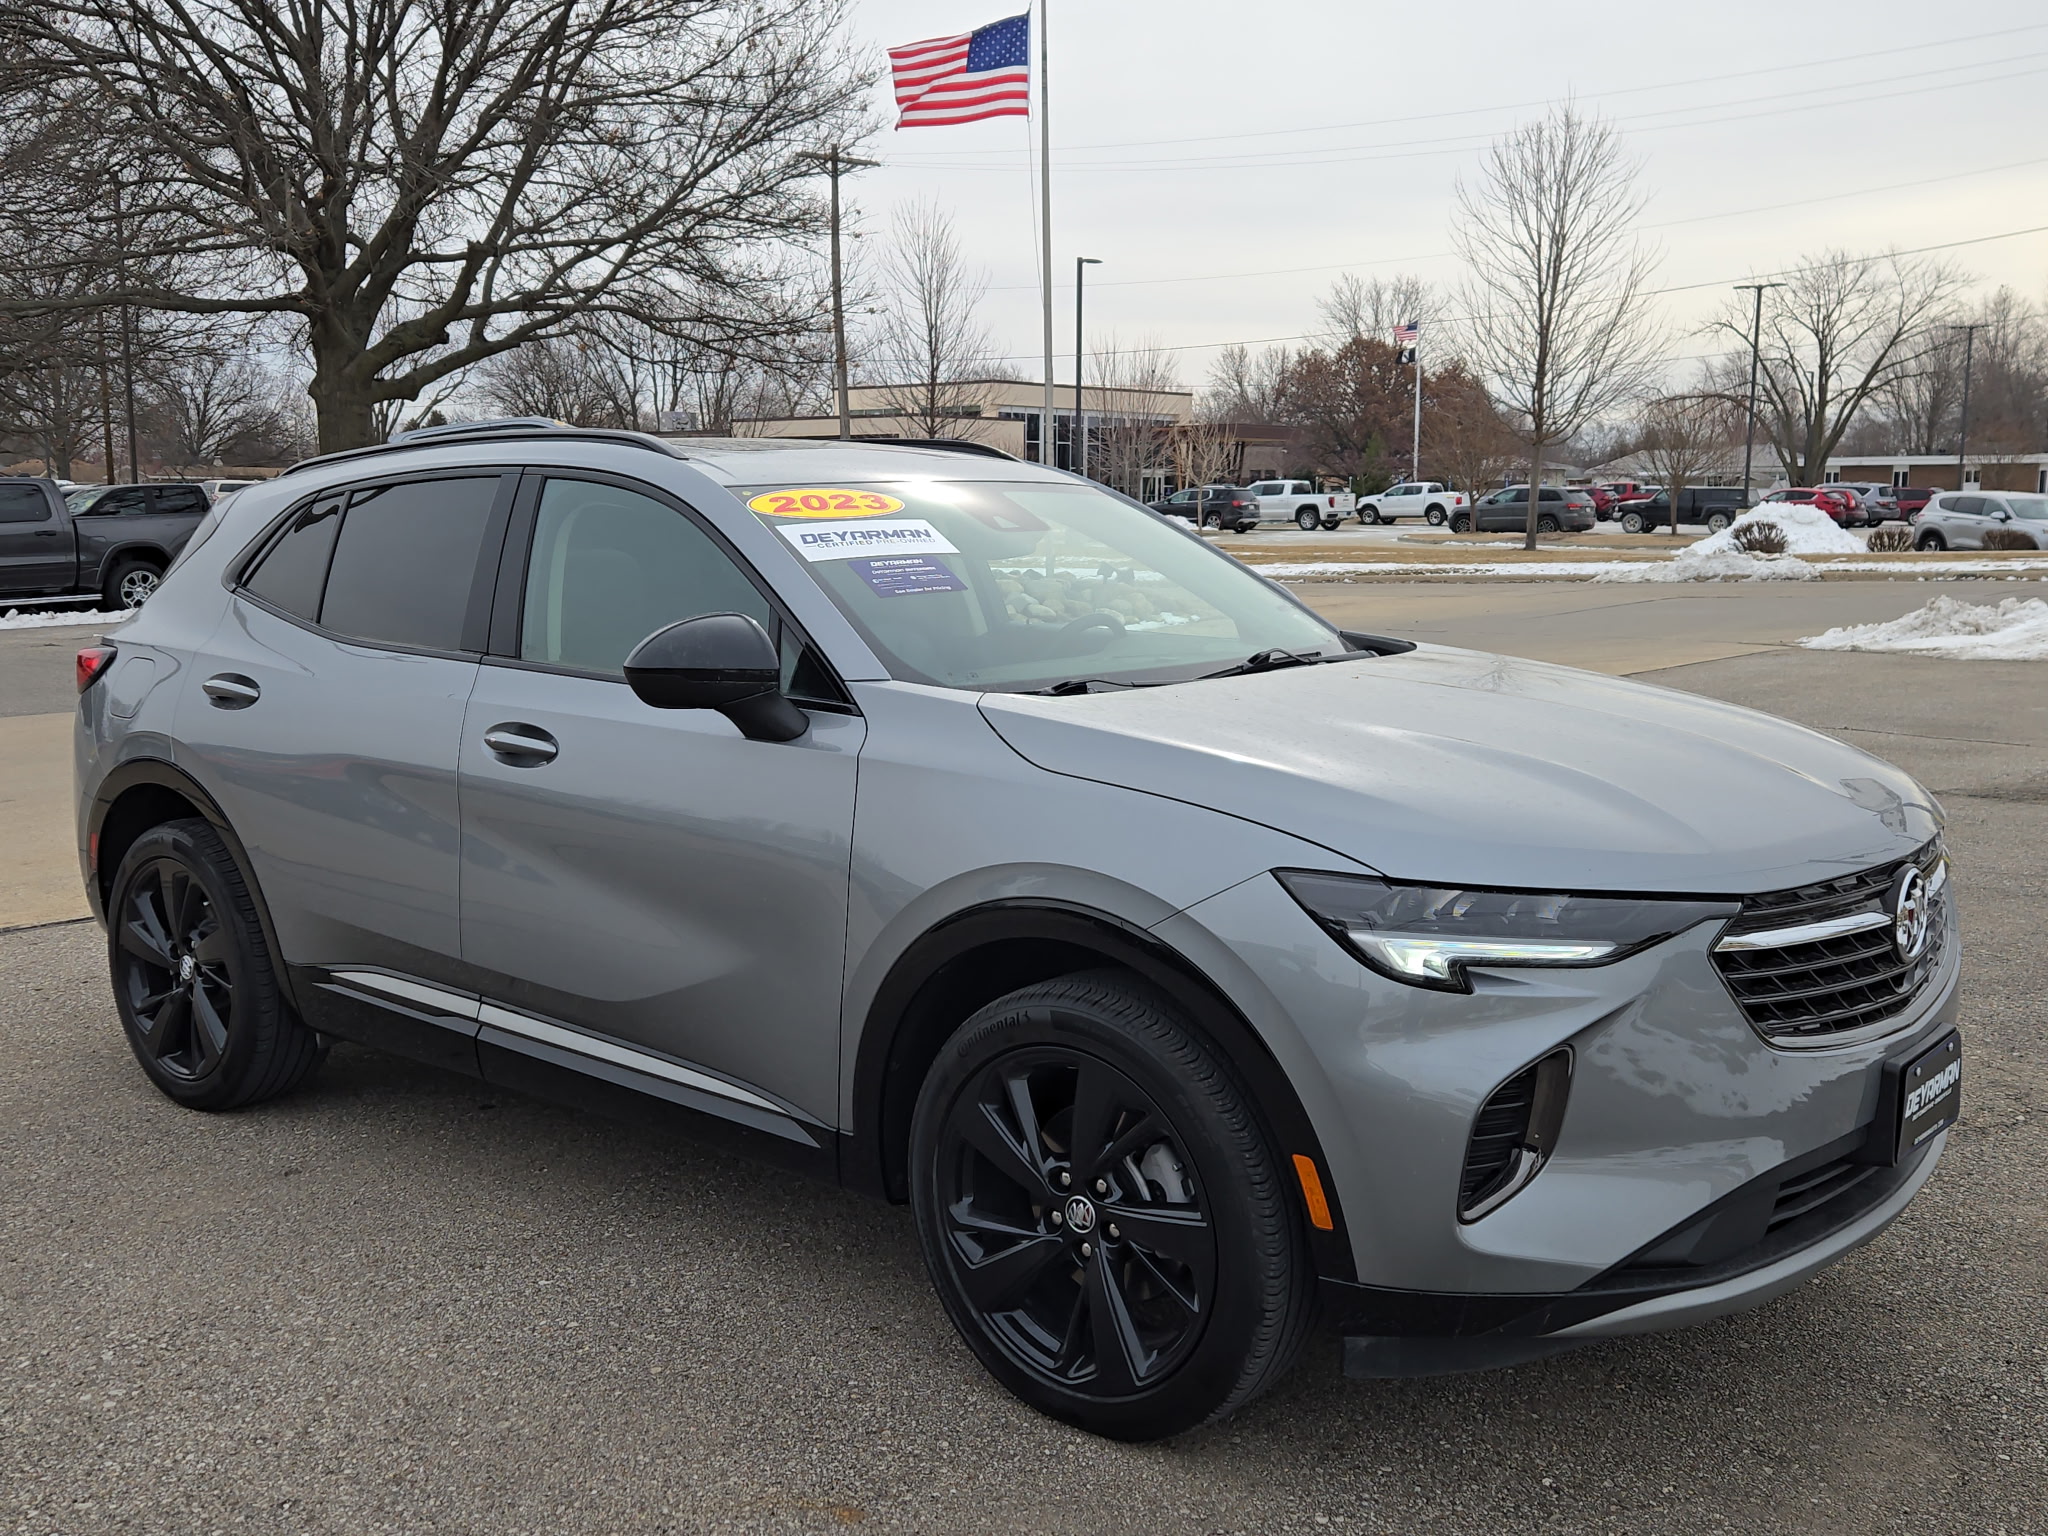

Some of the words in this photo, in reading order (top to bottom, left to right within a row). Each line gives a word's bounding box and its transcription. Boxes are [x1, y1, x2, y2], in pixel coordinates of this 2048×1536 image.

[769, 493, 890, 513] 2023
[800, 529, 932, 545] DEYARMAN
[817, 540, 872, 549] CERTIFIED
[869, 558, 923, 567] DEYARMAN
[1904, 1057, 1961, 1119] DEYARMAN
